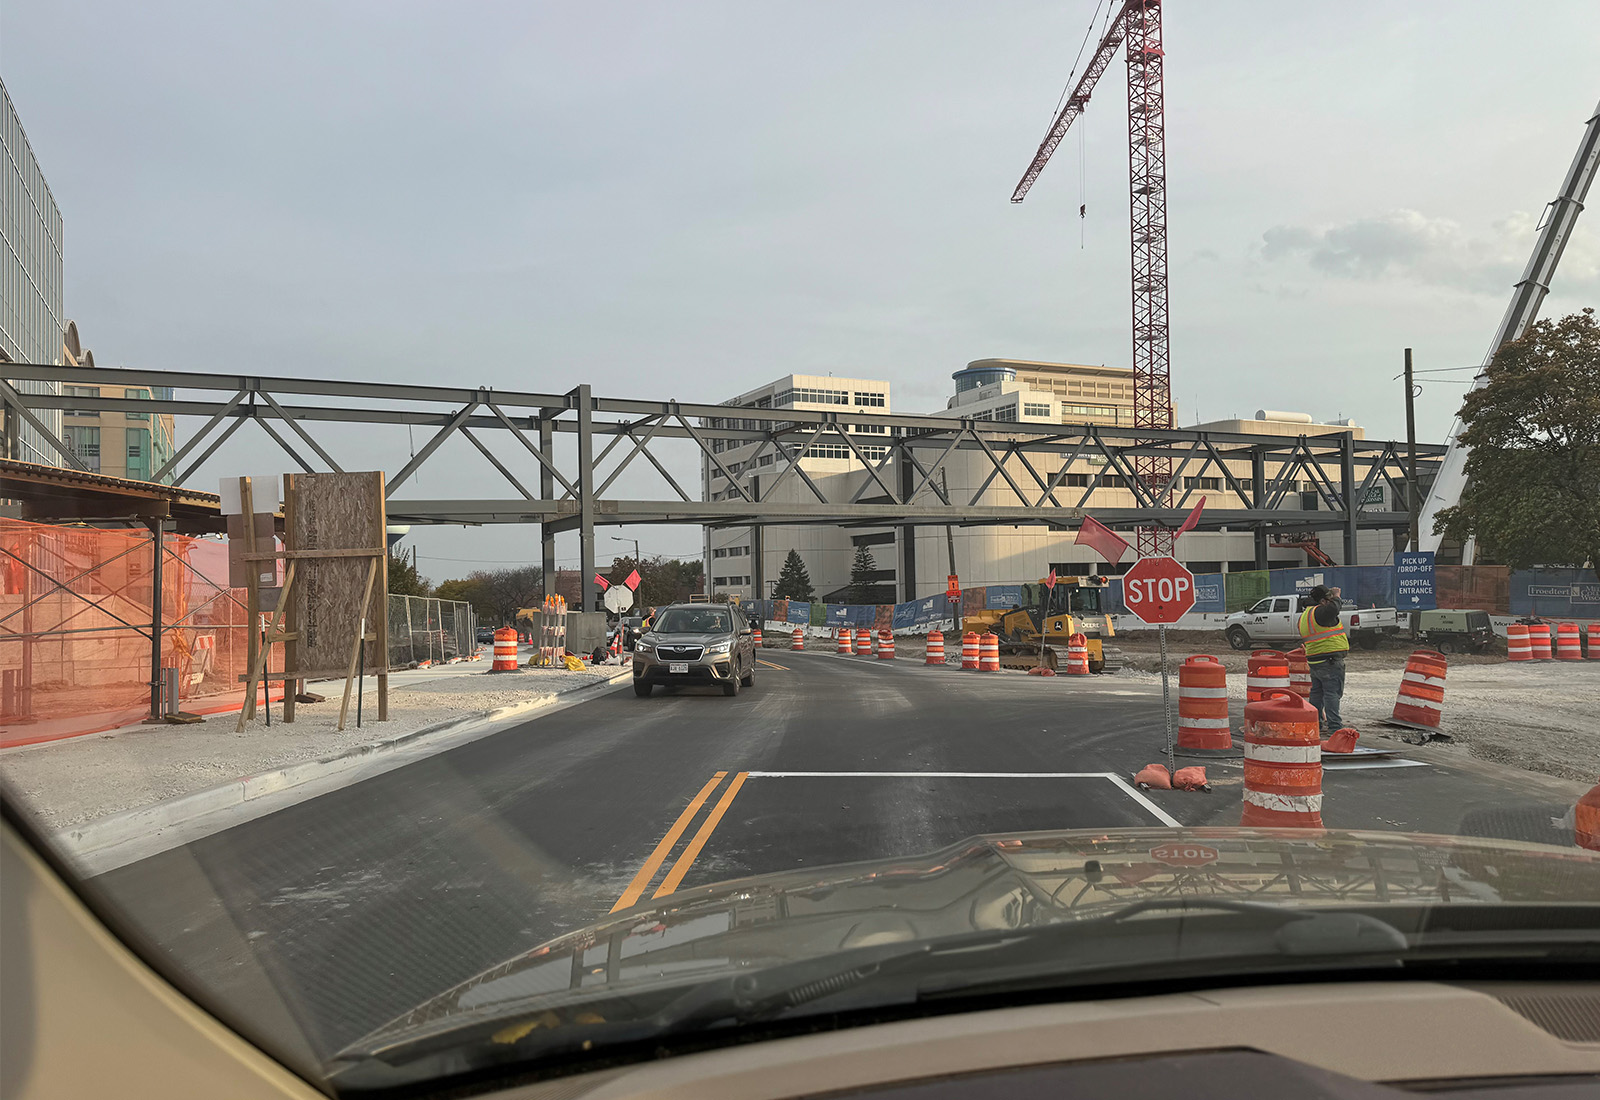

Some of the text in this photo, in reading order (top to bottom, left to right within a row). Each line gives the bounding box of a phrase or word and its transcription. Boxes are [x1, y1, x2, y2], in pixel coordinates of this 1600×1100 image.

[1402, 557, 1417, 565] PICK
[1397, 565, 1433, 573] /DROP-OFF
[1128, 577, 1189, 604] STOP
[1531, 587, 1569, 595] Froedtert
